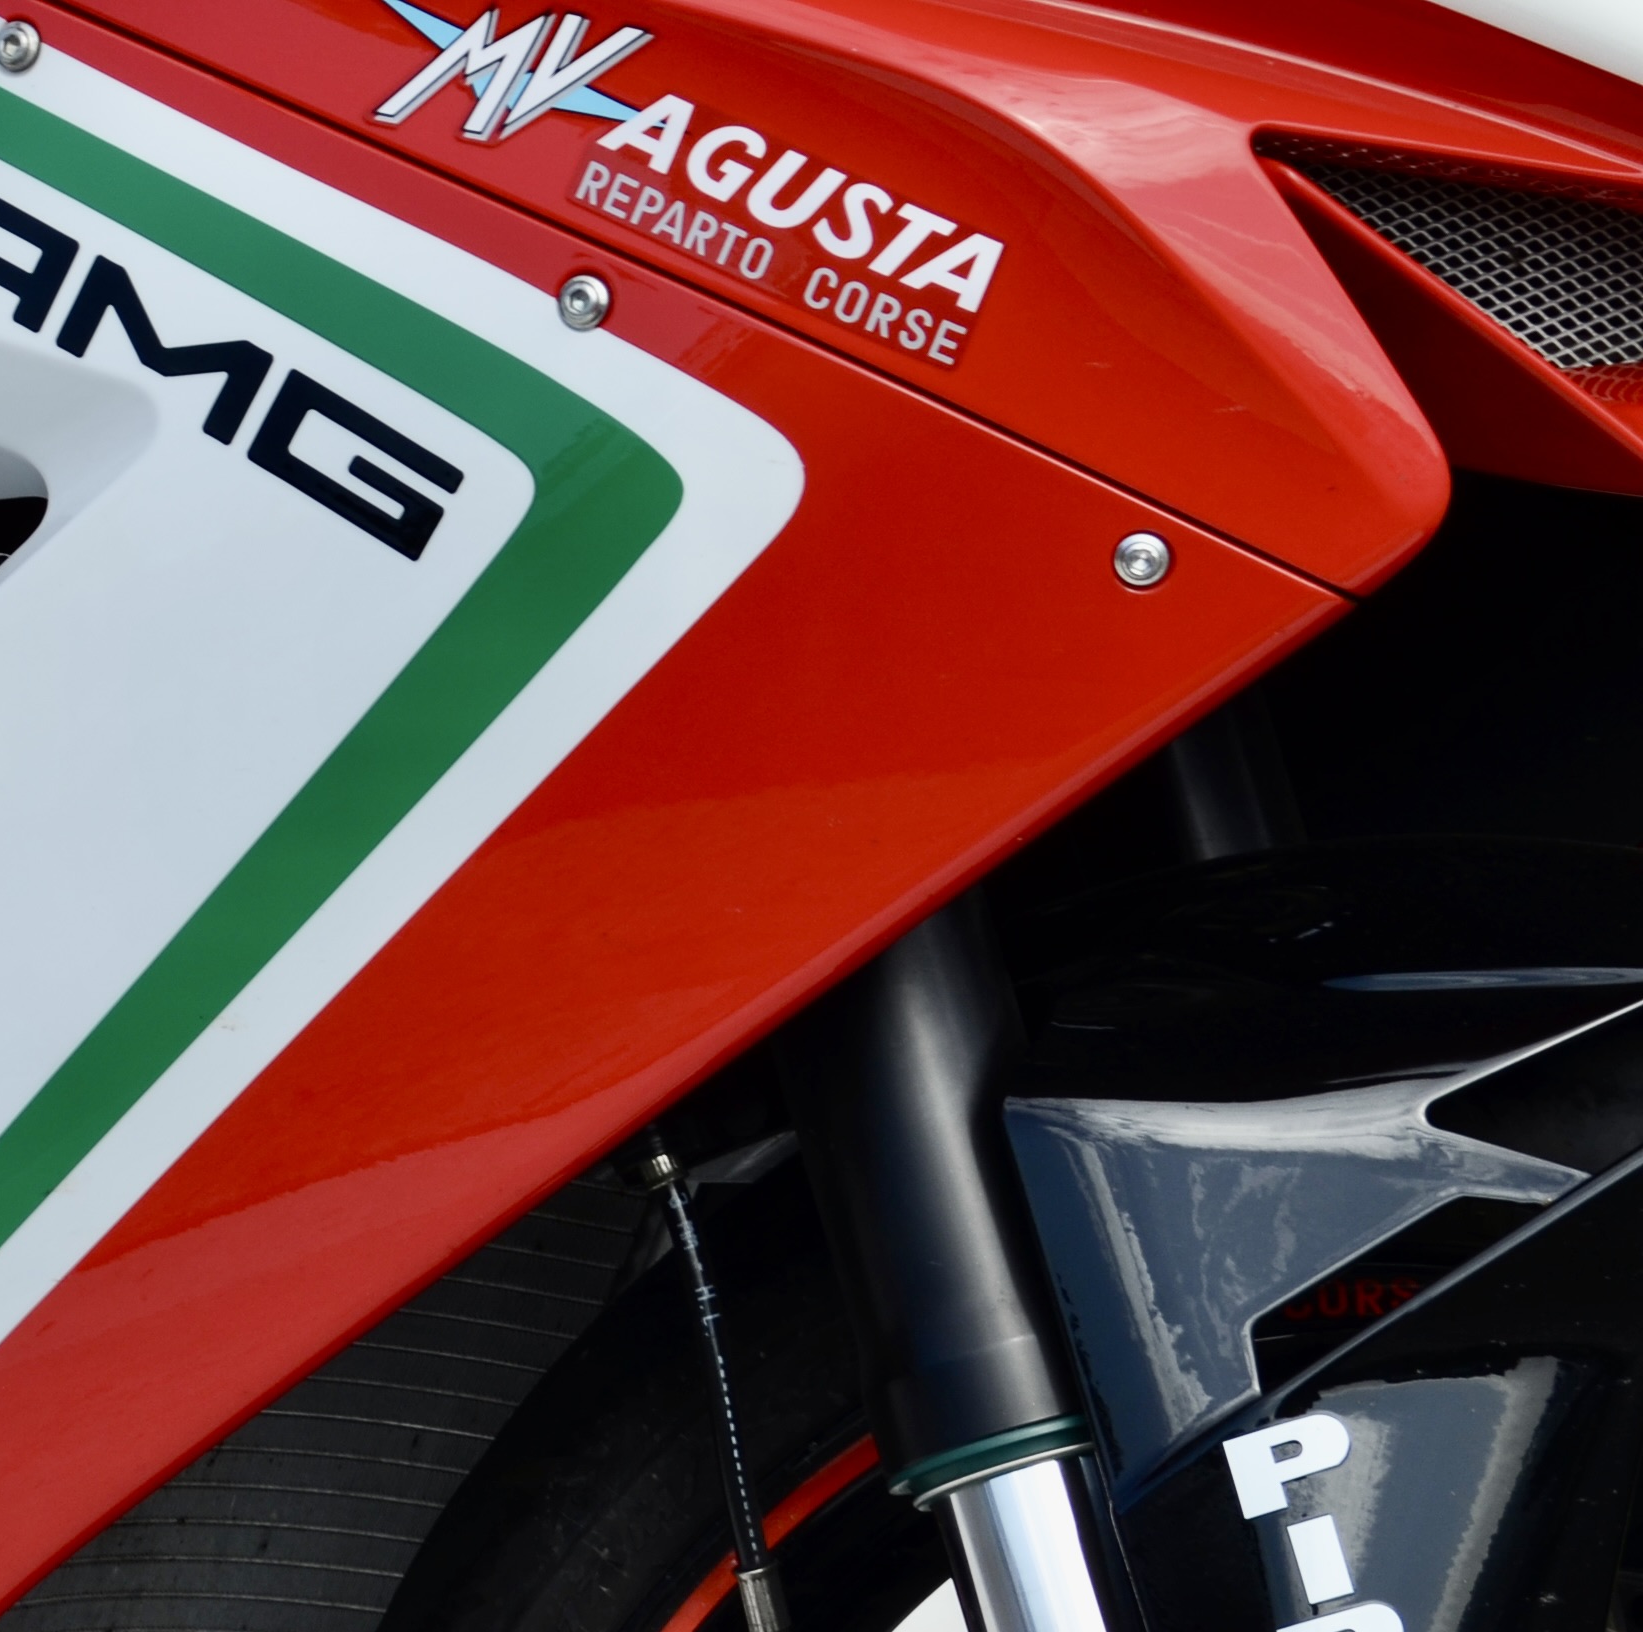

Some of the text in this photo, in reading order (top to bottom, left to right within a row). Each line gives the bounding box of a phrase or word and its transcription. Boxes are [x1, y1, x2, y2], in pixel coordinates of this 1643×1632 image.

[374, 6, 1005, 314] MV AGUSTA
[575, 160, 969, 367] REPARTO CORSE
